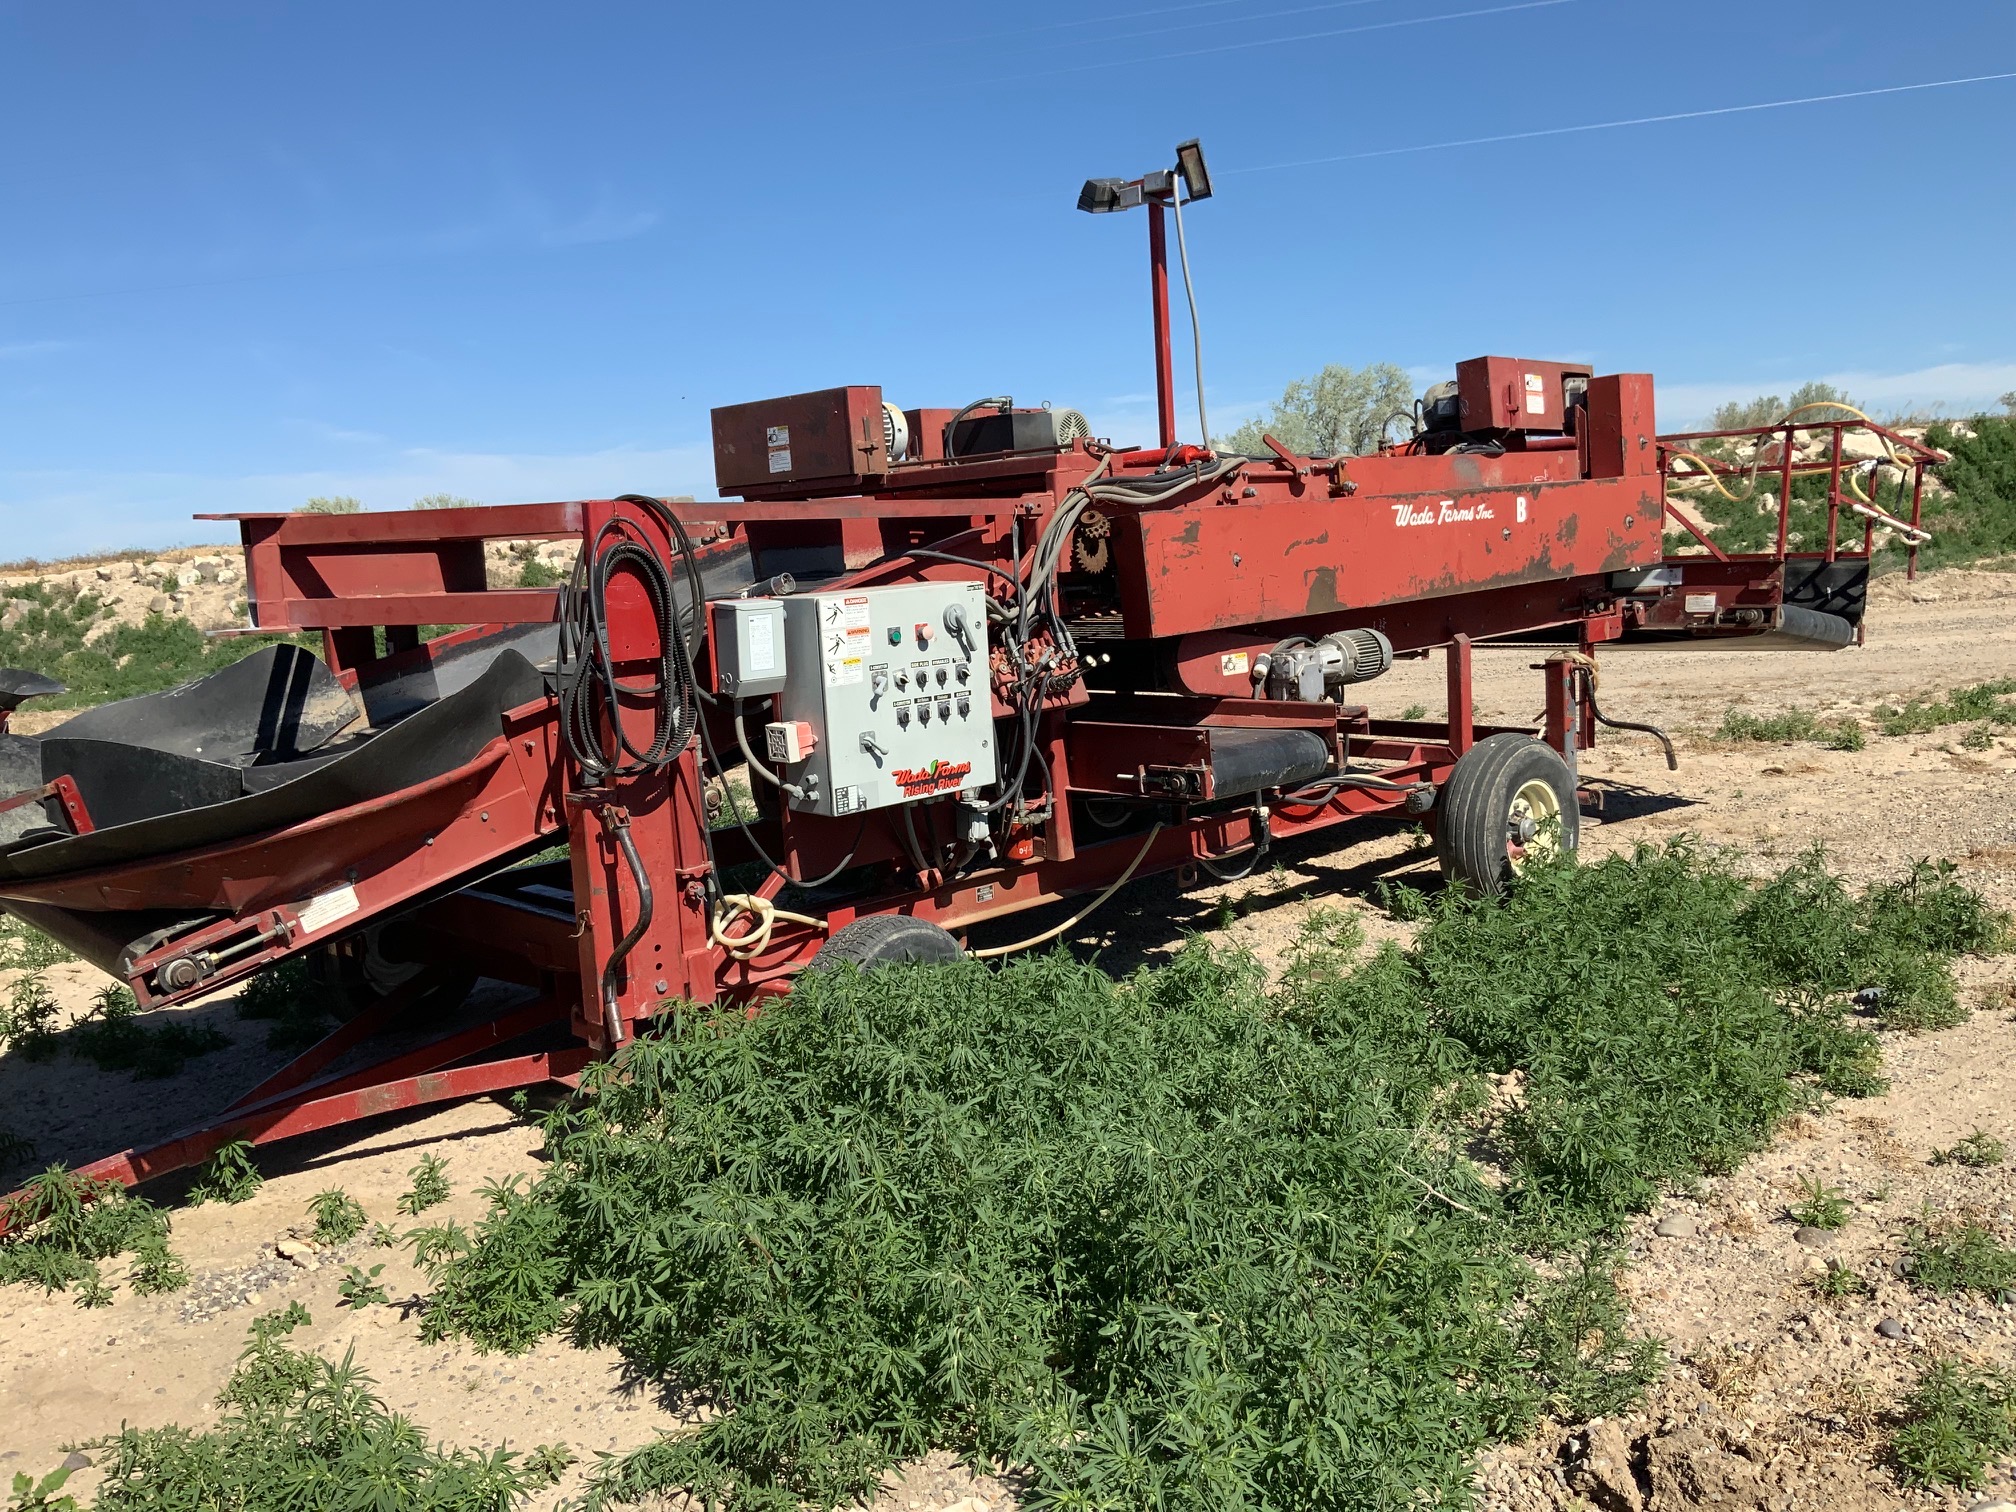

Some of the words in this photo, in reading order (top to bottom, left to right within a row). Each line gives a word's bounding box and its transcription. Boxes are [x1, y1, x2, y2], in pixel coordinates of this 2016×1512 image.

[1391, 504, 1435, 527] Wada
[1437, 500, 1475, 525] Farms
[1475, 503, 1495, 520] Inc.
[1516, 496, 1527, 523] B
[892, 766, 932, 787] Wada
[934, 761, 971, 780] Farms
[903, 783, 935, 798] Rising
[938, 777, 963, 791] River
